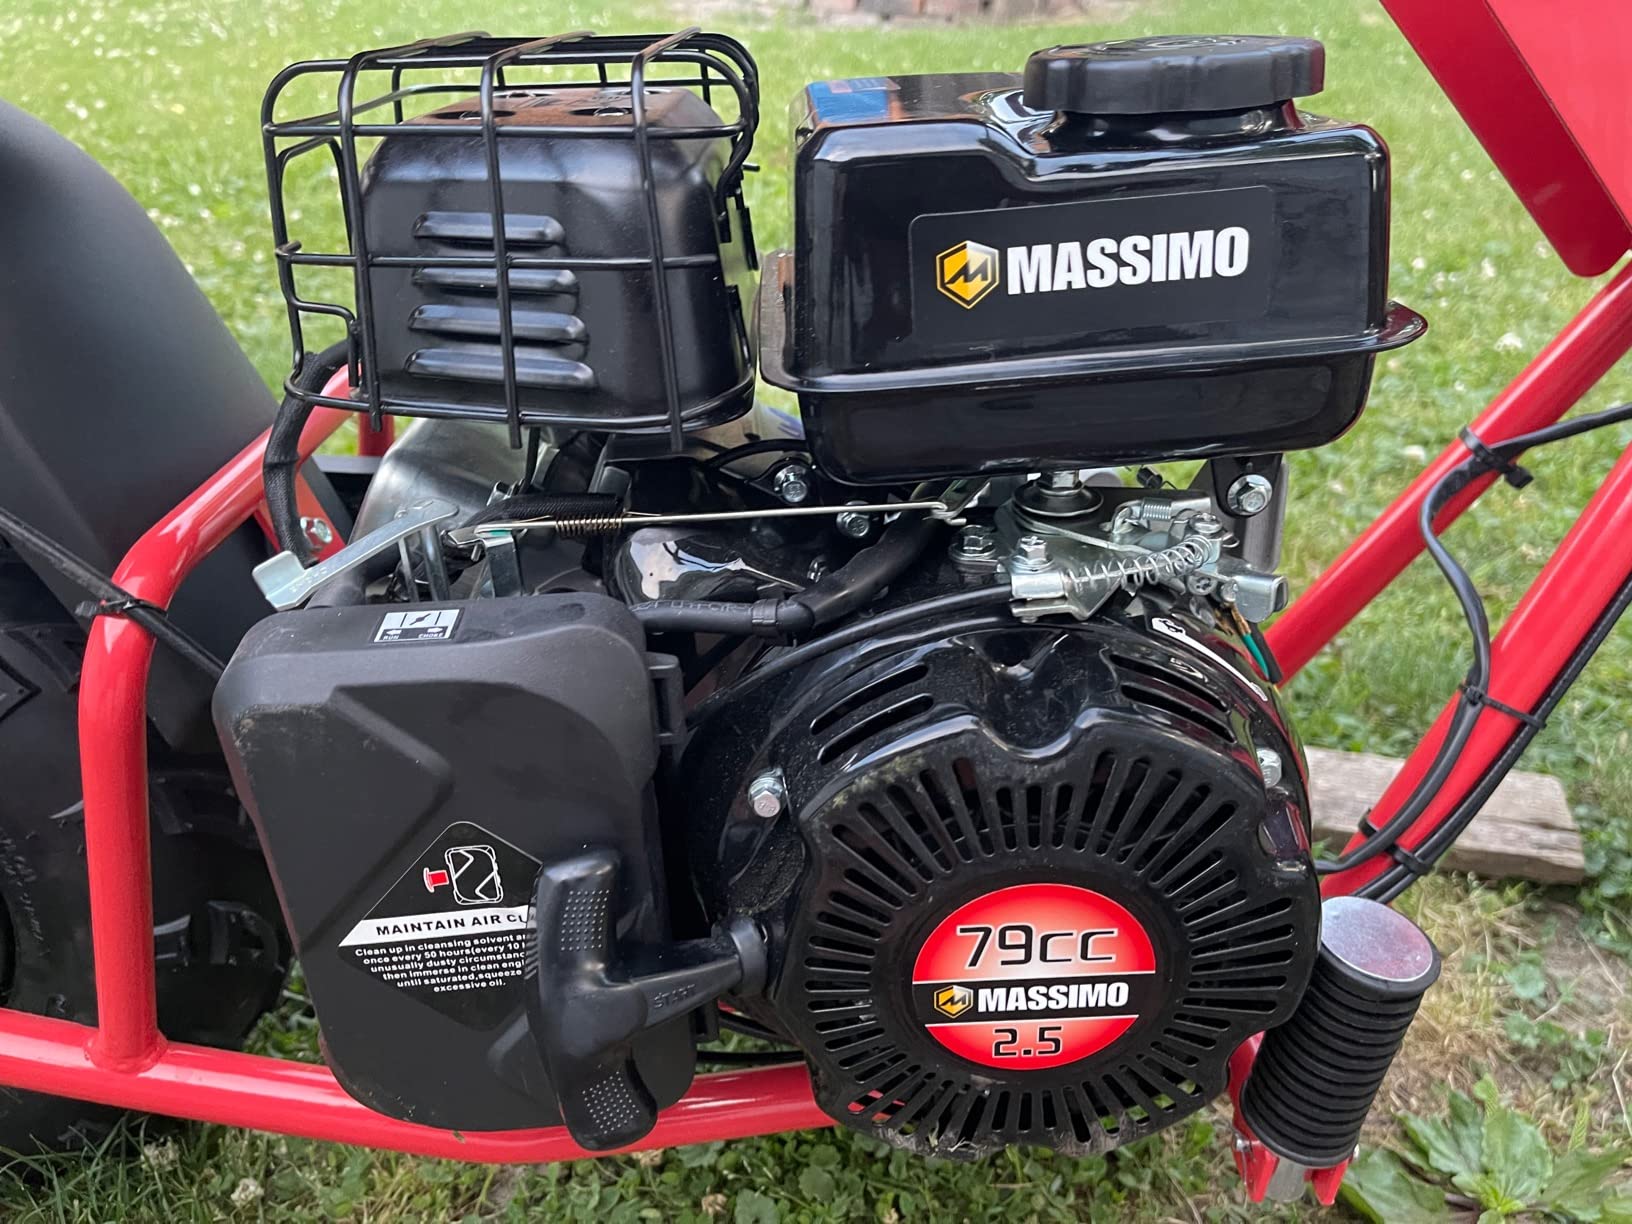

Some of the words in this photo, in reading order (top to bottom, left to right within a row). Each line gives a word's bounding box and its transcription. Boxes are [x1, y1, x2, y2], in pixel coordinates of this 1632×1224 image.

[1007, 226, 1249, 295] MASSIMO
[376, 918, 465, 936] MAINTAIN
[471, 914, 502, 926] AIR
[506, 914, 527, 924] CL
[355, 947, 387, 957] Clean
[389, 946, 403, 954] up
[404, 944, 416, 952] in
[417, 939, 471, 951] cleansing
[472, 934, 514, 944] solvent
[363, 956, 390, 965] once
[392, 952, 422, 961] every
[424, 950, 437, 959] 50
[439, 944, 504, 957] hours(every
[507, 942, 520, 950] 10
[958, 923, 1117, 968] 79cc
[371, 961, 424, 973] unusually
[426, 958, 456, 968] dusty
[458, 951, 525, 964] circumstanc
[383, 972, 408, 980] then
[409, 967, 456, 978] immerse
[470, 963, 500, 972] clean
[501, 959, 525, 969] engi
[397, 978, 422, 987] until
[423, 969, 522, 985] saturated,squeeze
[433, 982, 487, 992] excessive
[489, 979, 506, 987] oil.
[978, 982, 1129, 1013] MASSIMO
[992, 1026, 1062, 1058] 2.5
